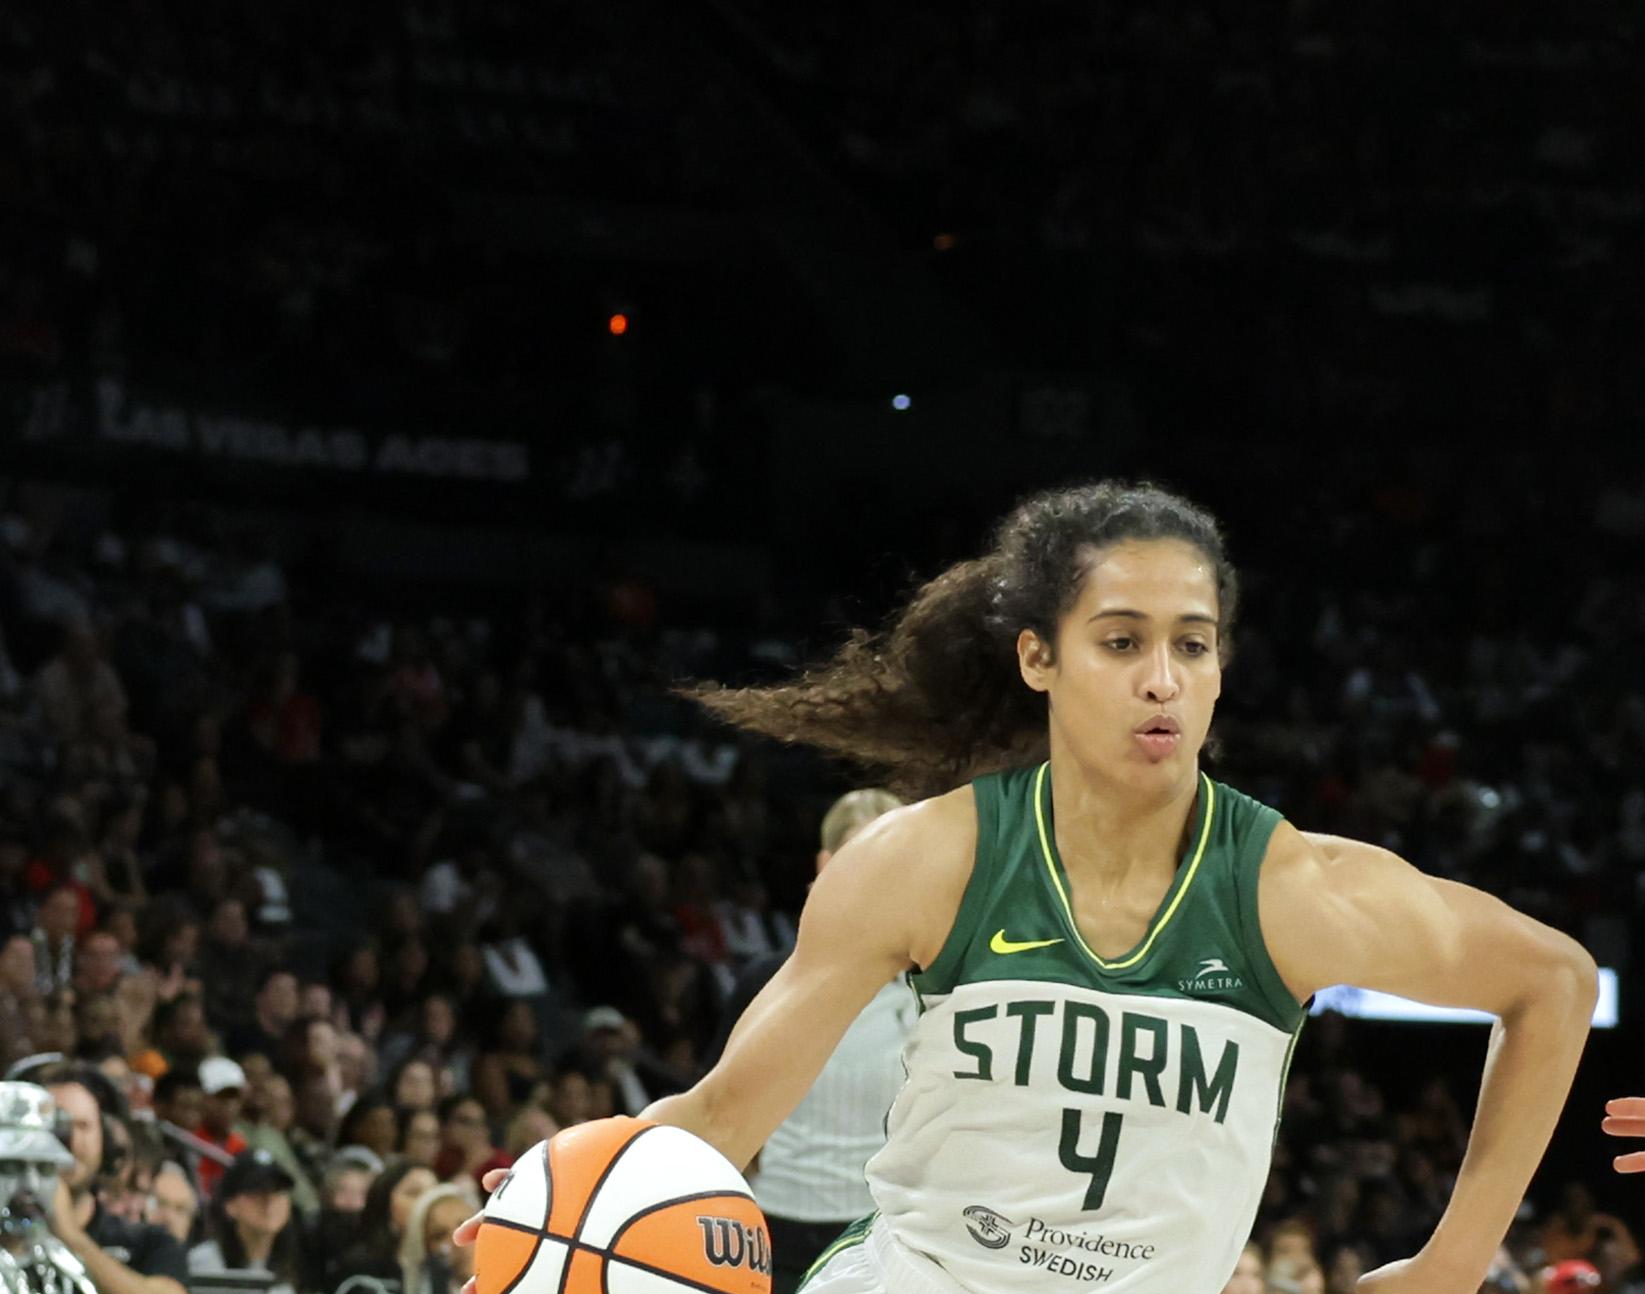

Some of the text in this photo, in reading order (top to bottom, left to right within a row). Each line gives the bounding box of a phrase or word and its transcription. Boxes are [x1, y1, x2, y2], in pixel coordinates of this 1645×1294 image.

[1178, 977, 1243, 991] SYMETRA
[953, 1000, 1239, 1124] STORM
[1058, 1108, 1123, 1212] 4
[696, 1215, 771, 1278] Wil
[1019, 1245, 1113, 1281] SWEDISH
[1024, 1217, 1155, 1260] Providence
